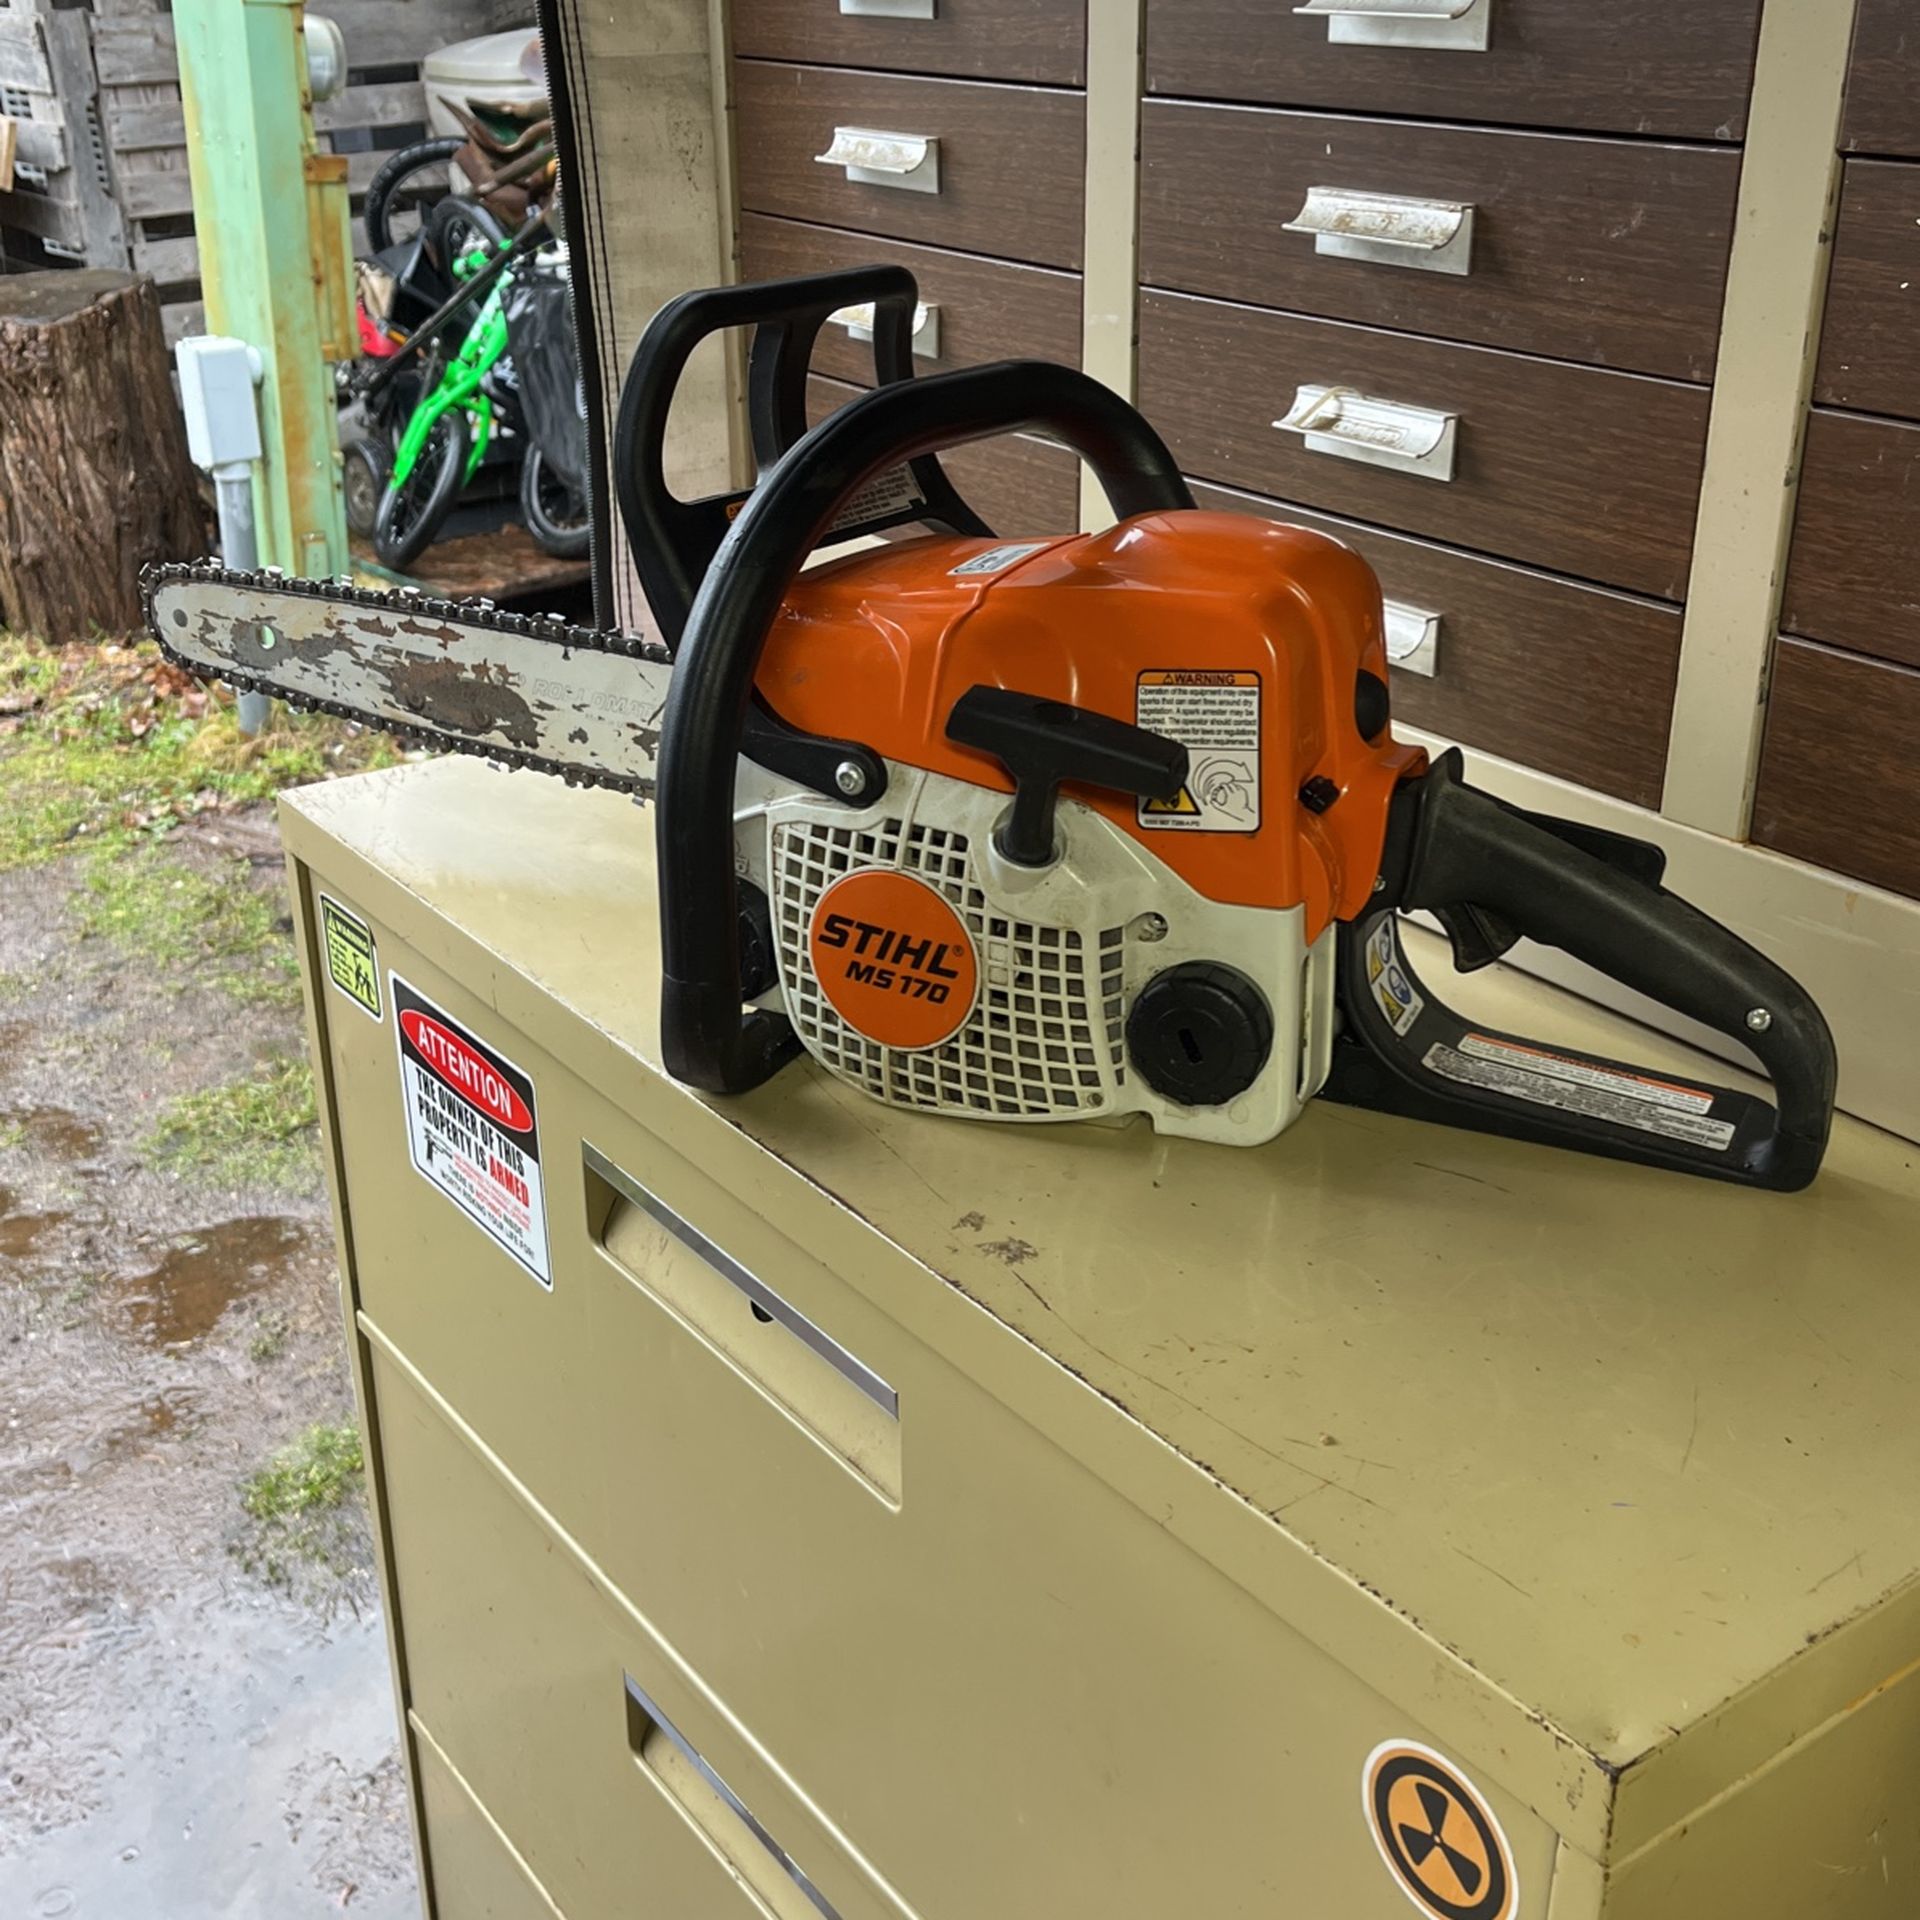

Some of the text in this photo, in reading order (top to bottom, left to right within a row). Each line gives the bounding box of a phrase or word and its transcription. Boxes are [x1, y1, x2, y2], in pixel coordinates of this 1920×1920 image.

[1140, 687, 1169, 696] Operation
[1189, 688, 1222, 698] equipment
[1223, 690, 1236, 698] may
[1175, 673, 1236, 685] WARNING
[1182, 708, 1200, 717] spark
[1229, 710, 1244, 718] may
[1219, 698, 1241, 706] around
[1242, 698, 1254, 708] dry
[1182, 718, 1208, 727] operator
[1210, 718, 1231, 726] should
[817, 913, 959, 980] STIHL
[845, 960, 950, 1005] MS 170
[419, 1020, 513, 1120] ATTENTION
[415, 1066, 525, 1177] THE OWNER OF THIS
[417, 1093, 472, 1159] PROPERTY
[474, 1141, 487, 1172] IS
[489, 1153, 530, 1209] ARMED
